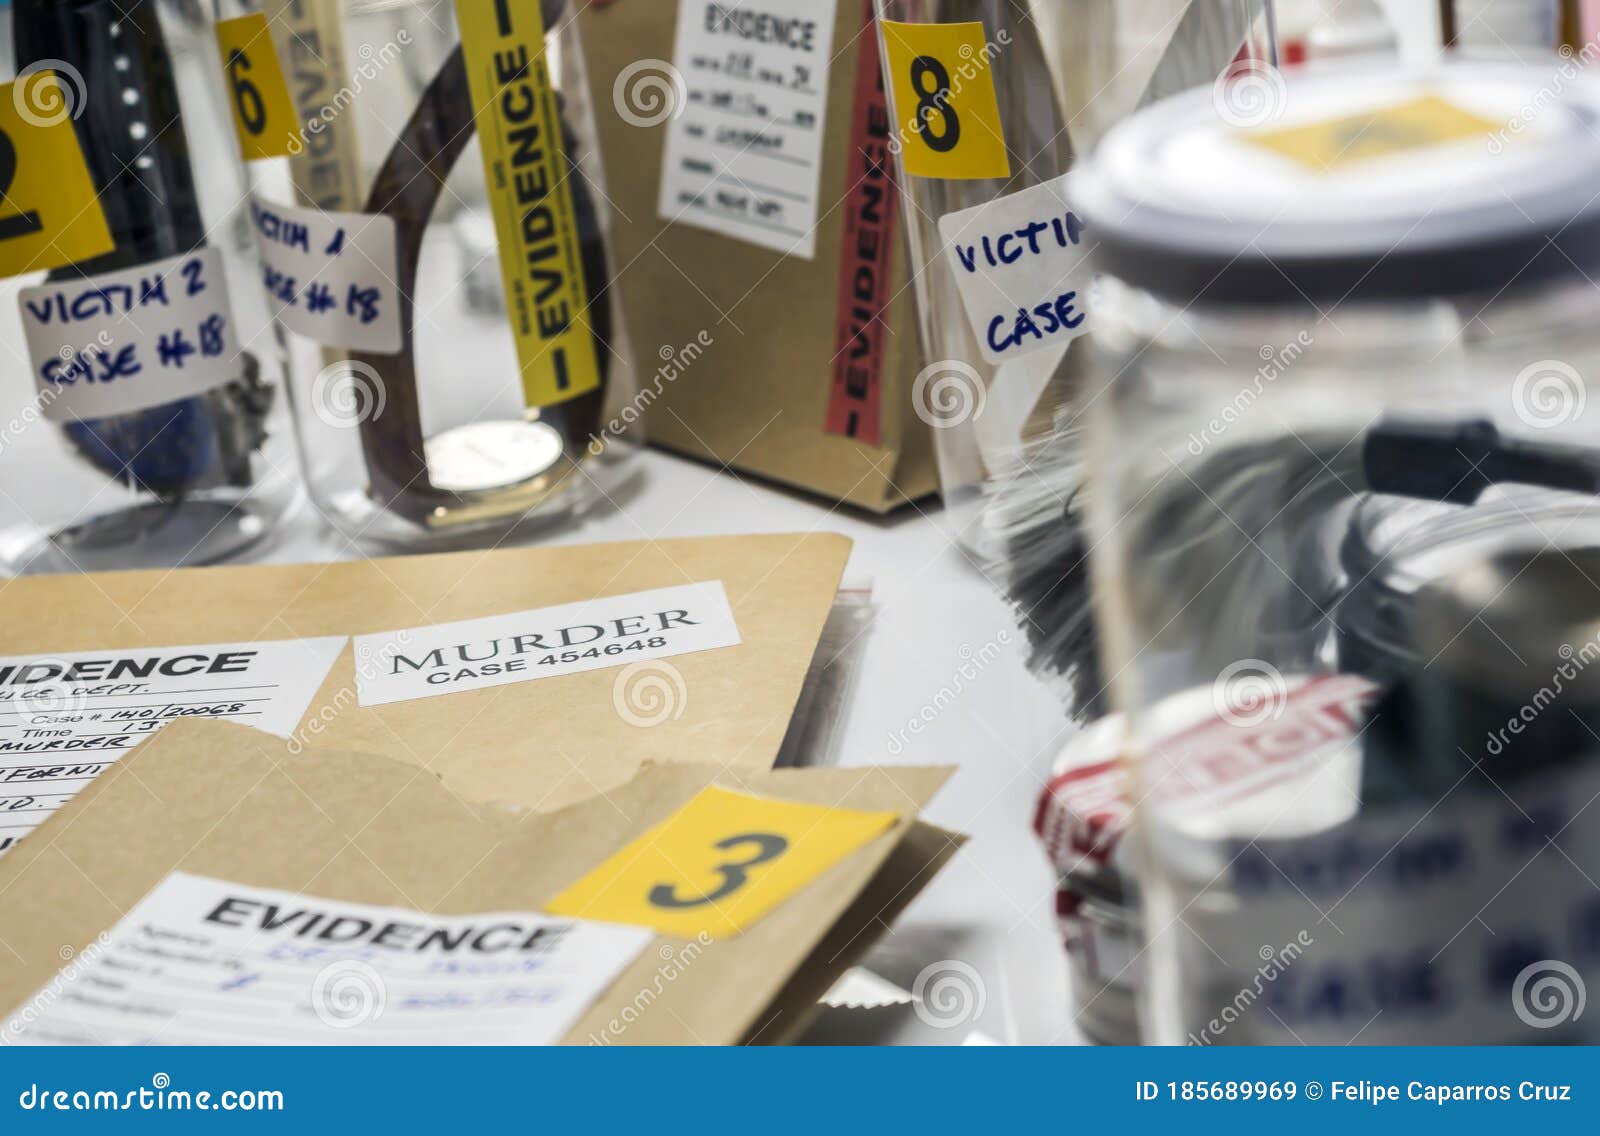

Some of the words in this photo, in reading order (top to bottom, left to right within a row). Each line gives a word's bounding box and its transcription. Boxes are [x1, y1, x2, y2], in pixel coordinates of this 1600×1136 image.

[228, 48, 266, 136] 6
[911, 56, 960, 152] 8
[496, 45, 571, 340] EVIDENCE
[845, 105, 890, 402] EVIDENCE
[26, 274, 169, 325] VICTIM
[181, 258, 207, 297] 2
[987, 290, 1085, 353] CASE
[40, 343, 143, 387] CASE
[0, 651, 258, 686] IDENCE
[388, 608, 702, 676] MURDER
[426, 658, 527, 685] CASE
[537, 637, 667, 667] 454648
[0, 736, 130, 751] MURDER
[22, 729, 73, 739] Time
[31, 714, 84, 725] Case
[647, 832, 788, 910] 3
[205, 896, 574, 954] EVIDENCE
